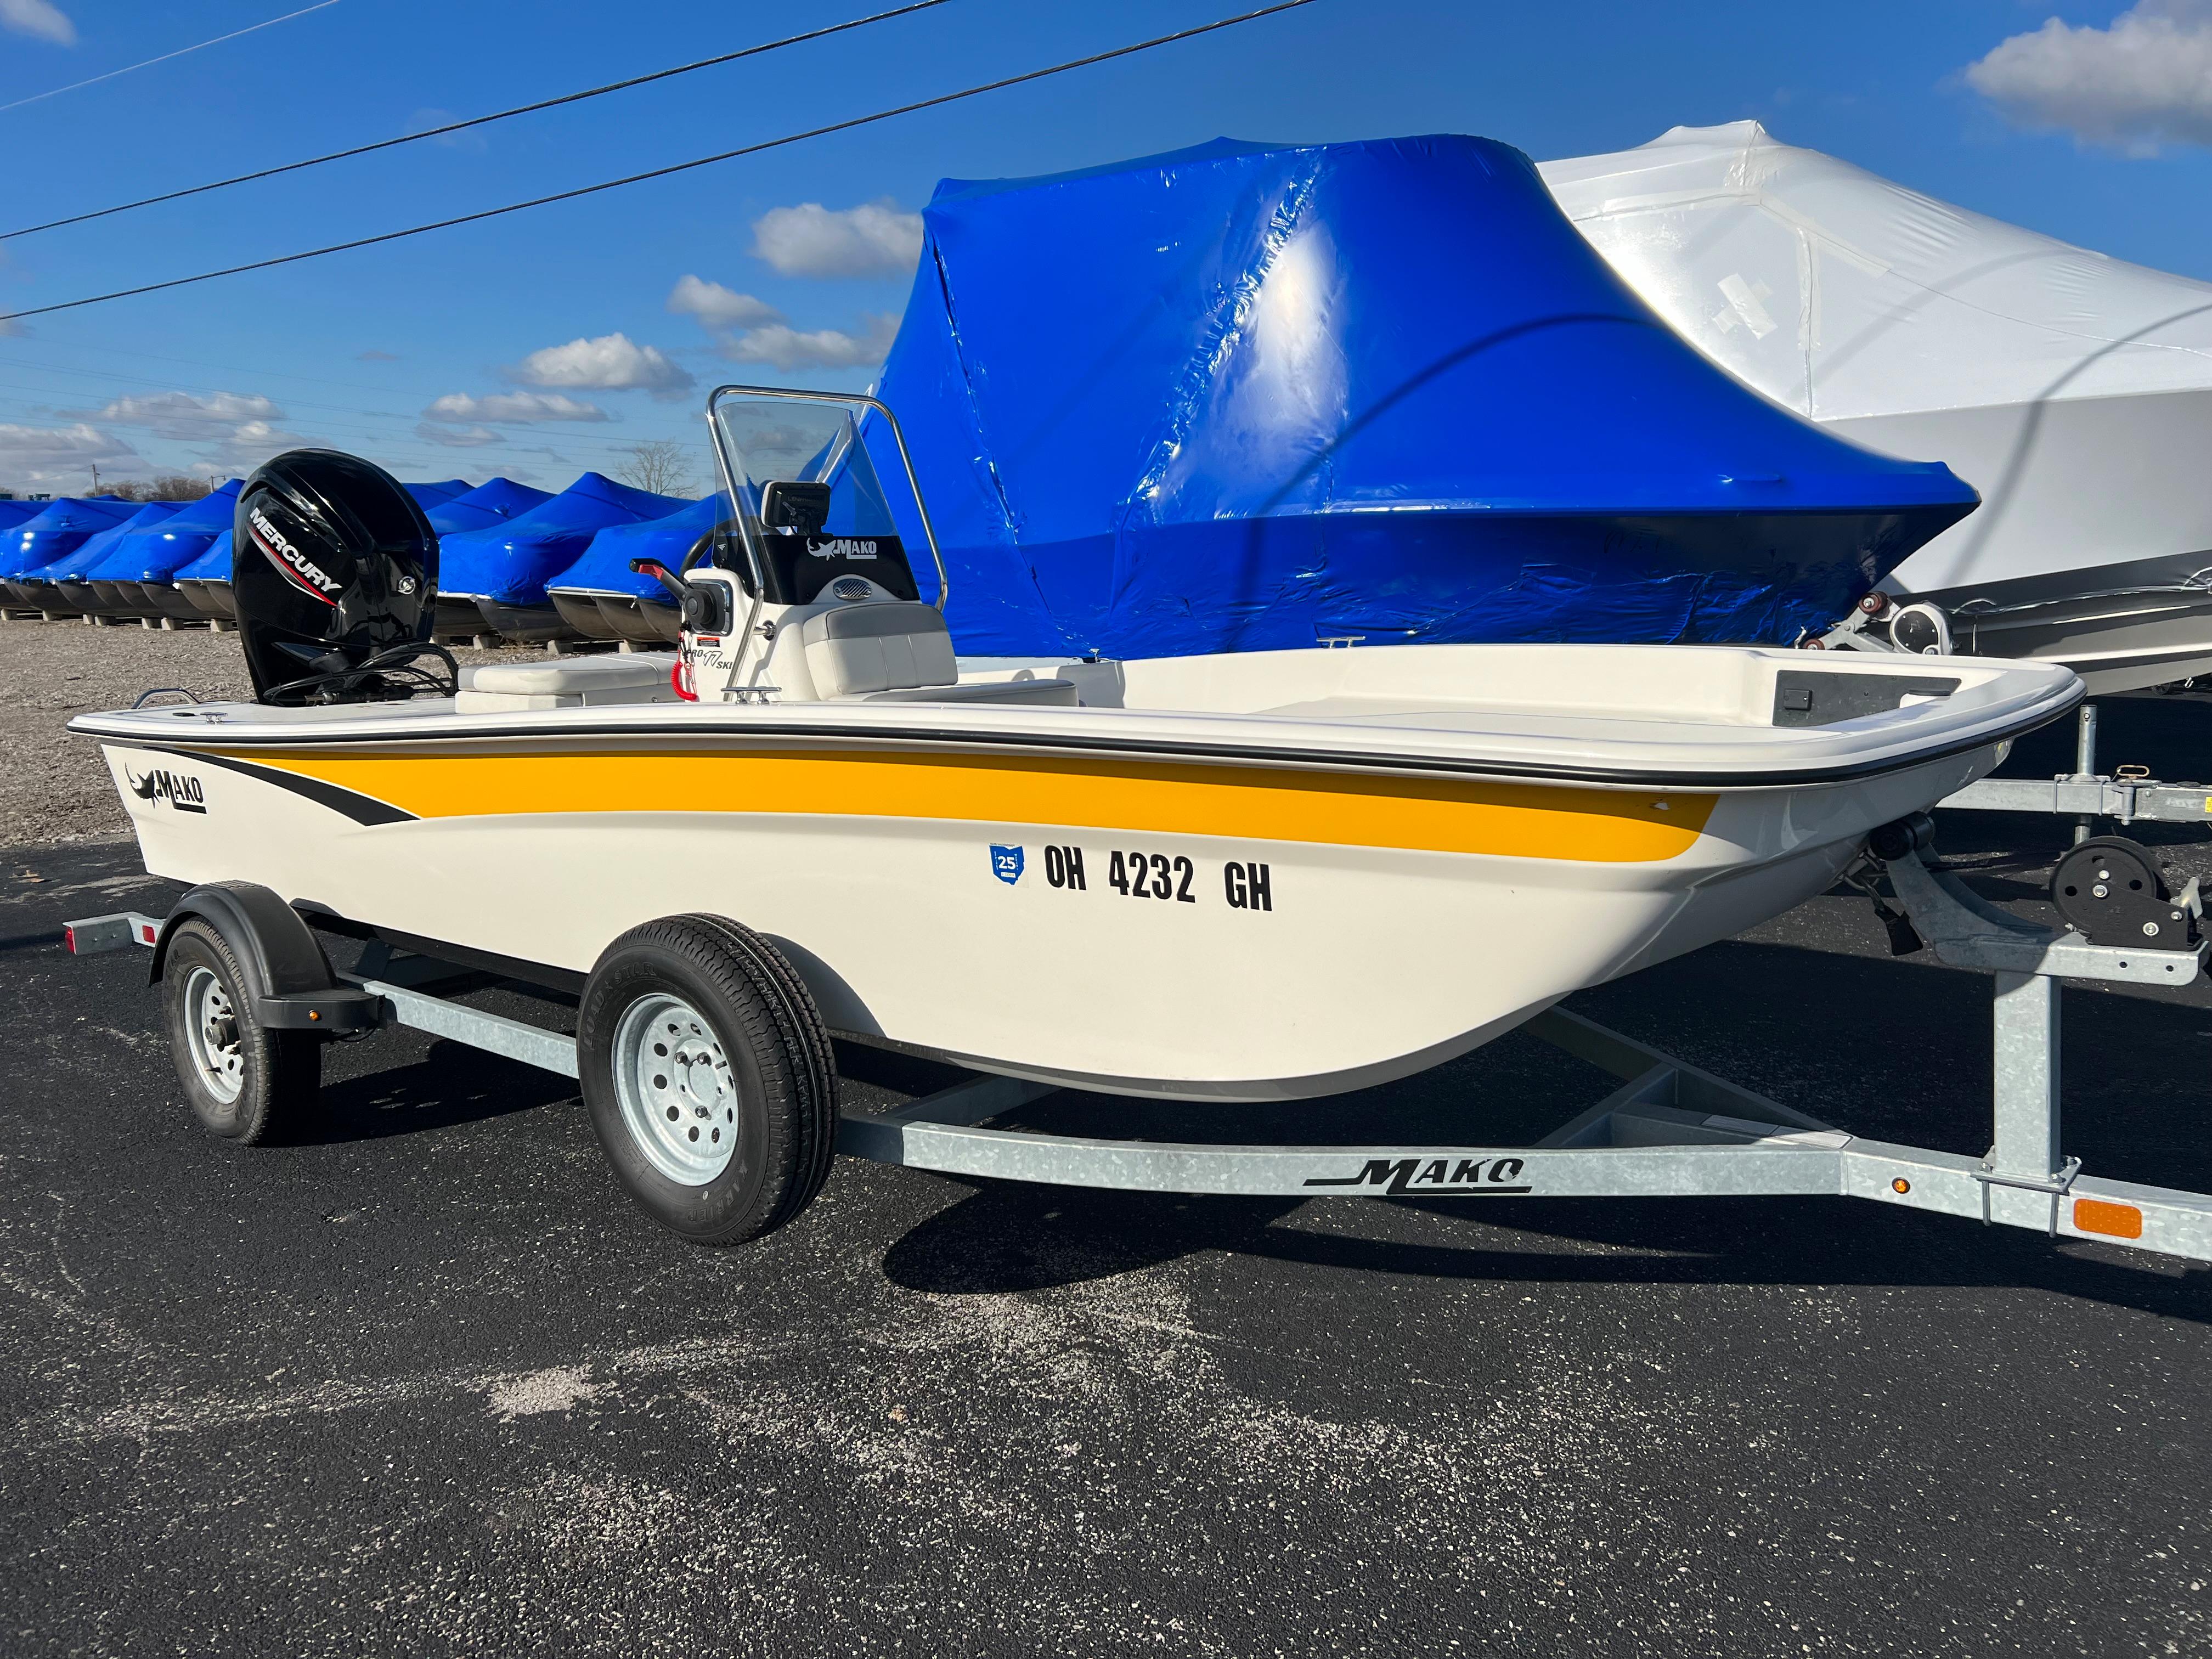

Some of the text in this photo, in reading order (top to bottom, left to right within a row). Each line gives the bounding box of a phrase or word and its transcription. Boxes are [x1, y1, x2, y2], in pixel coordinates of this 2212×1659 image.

[250, 507, 342, 592] MERCURY
[834, 539, 877, 560] MAKO
[703, 651, 723, 667] 17
[716, 661, 733, 669] SKI
[155, 770, 207, 815] MAKO
[997, 856, 1016, 870] 25
[1044, 845, 1273, 912] OH 4232 GH
[614, 962, 657, 984] STAR
[1302, 1158, 1533, 1195] MAKO
